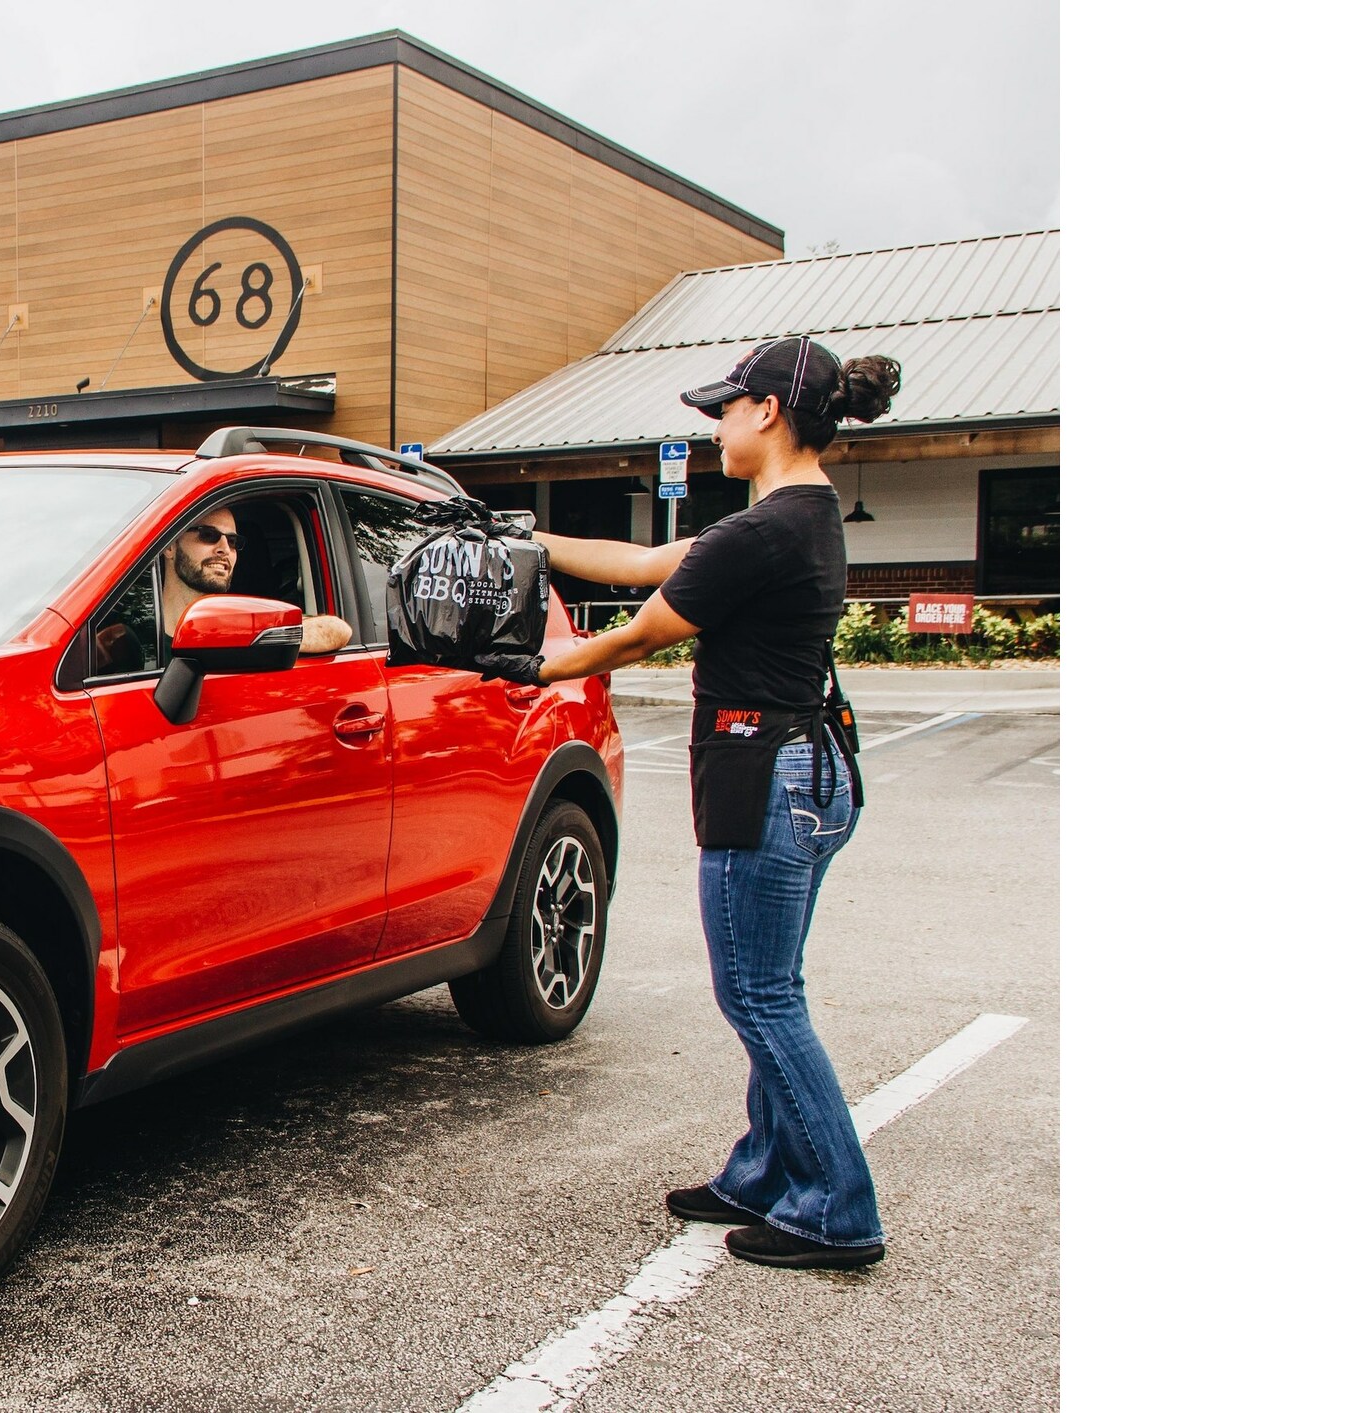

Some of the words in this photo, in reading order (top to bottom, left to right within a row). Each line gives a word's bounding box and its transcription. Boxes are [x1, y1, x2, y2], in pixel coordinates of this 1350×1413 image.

[188, 262, 273, 329] 68
[28, 403, 58, 418] 2210
[414, 575, 466, 608] BBQ
[916, 603, 943, 614] PLACE
[943, 603, 966, 614] YOUR
[915, 613, 943, 624] ORDER
[943, 613, 966, 624] HERE
[717, 709, 762, 724] SONNY'S
